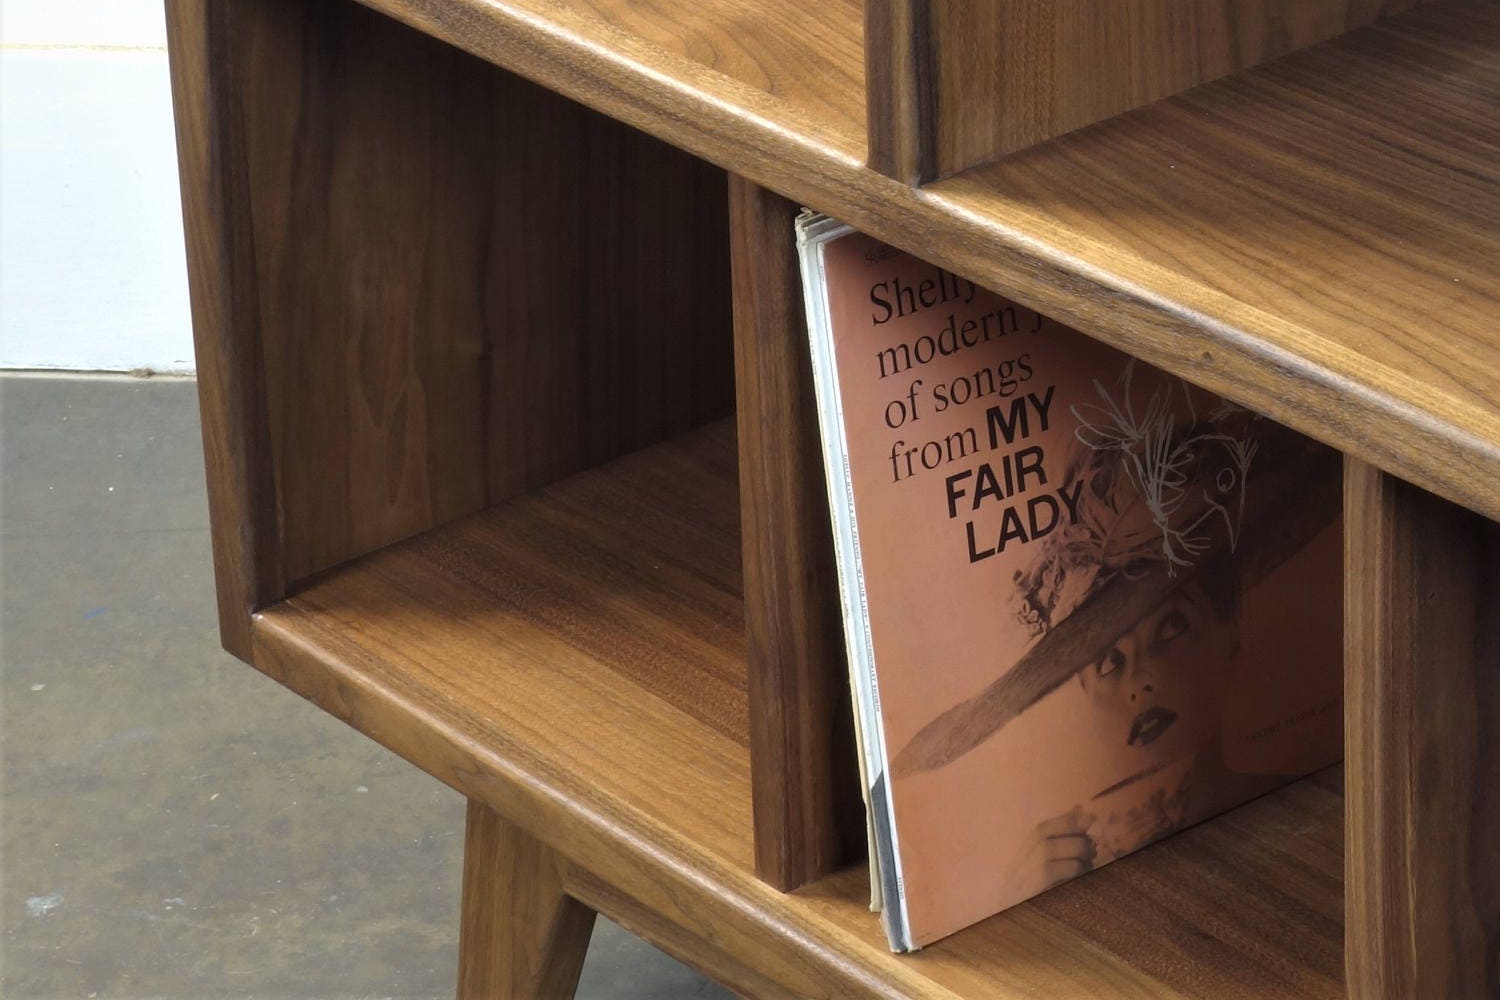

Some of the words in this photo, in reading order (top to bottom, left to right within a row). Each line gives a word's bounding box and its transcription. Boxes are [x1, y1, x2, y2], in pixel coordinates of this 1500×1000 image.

[877, 306, 1019, 379] modern
[885, 379, 923, 429] of
[933, 353, 1033, 412] songs
[889, 427, 979, 483] from
[986, 385, 1056, 451] MY
[946, 446, 1048, 519] FAIR
[966, 480, 1084, 563] LADY
